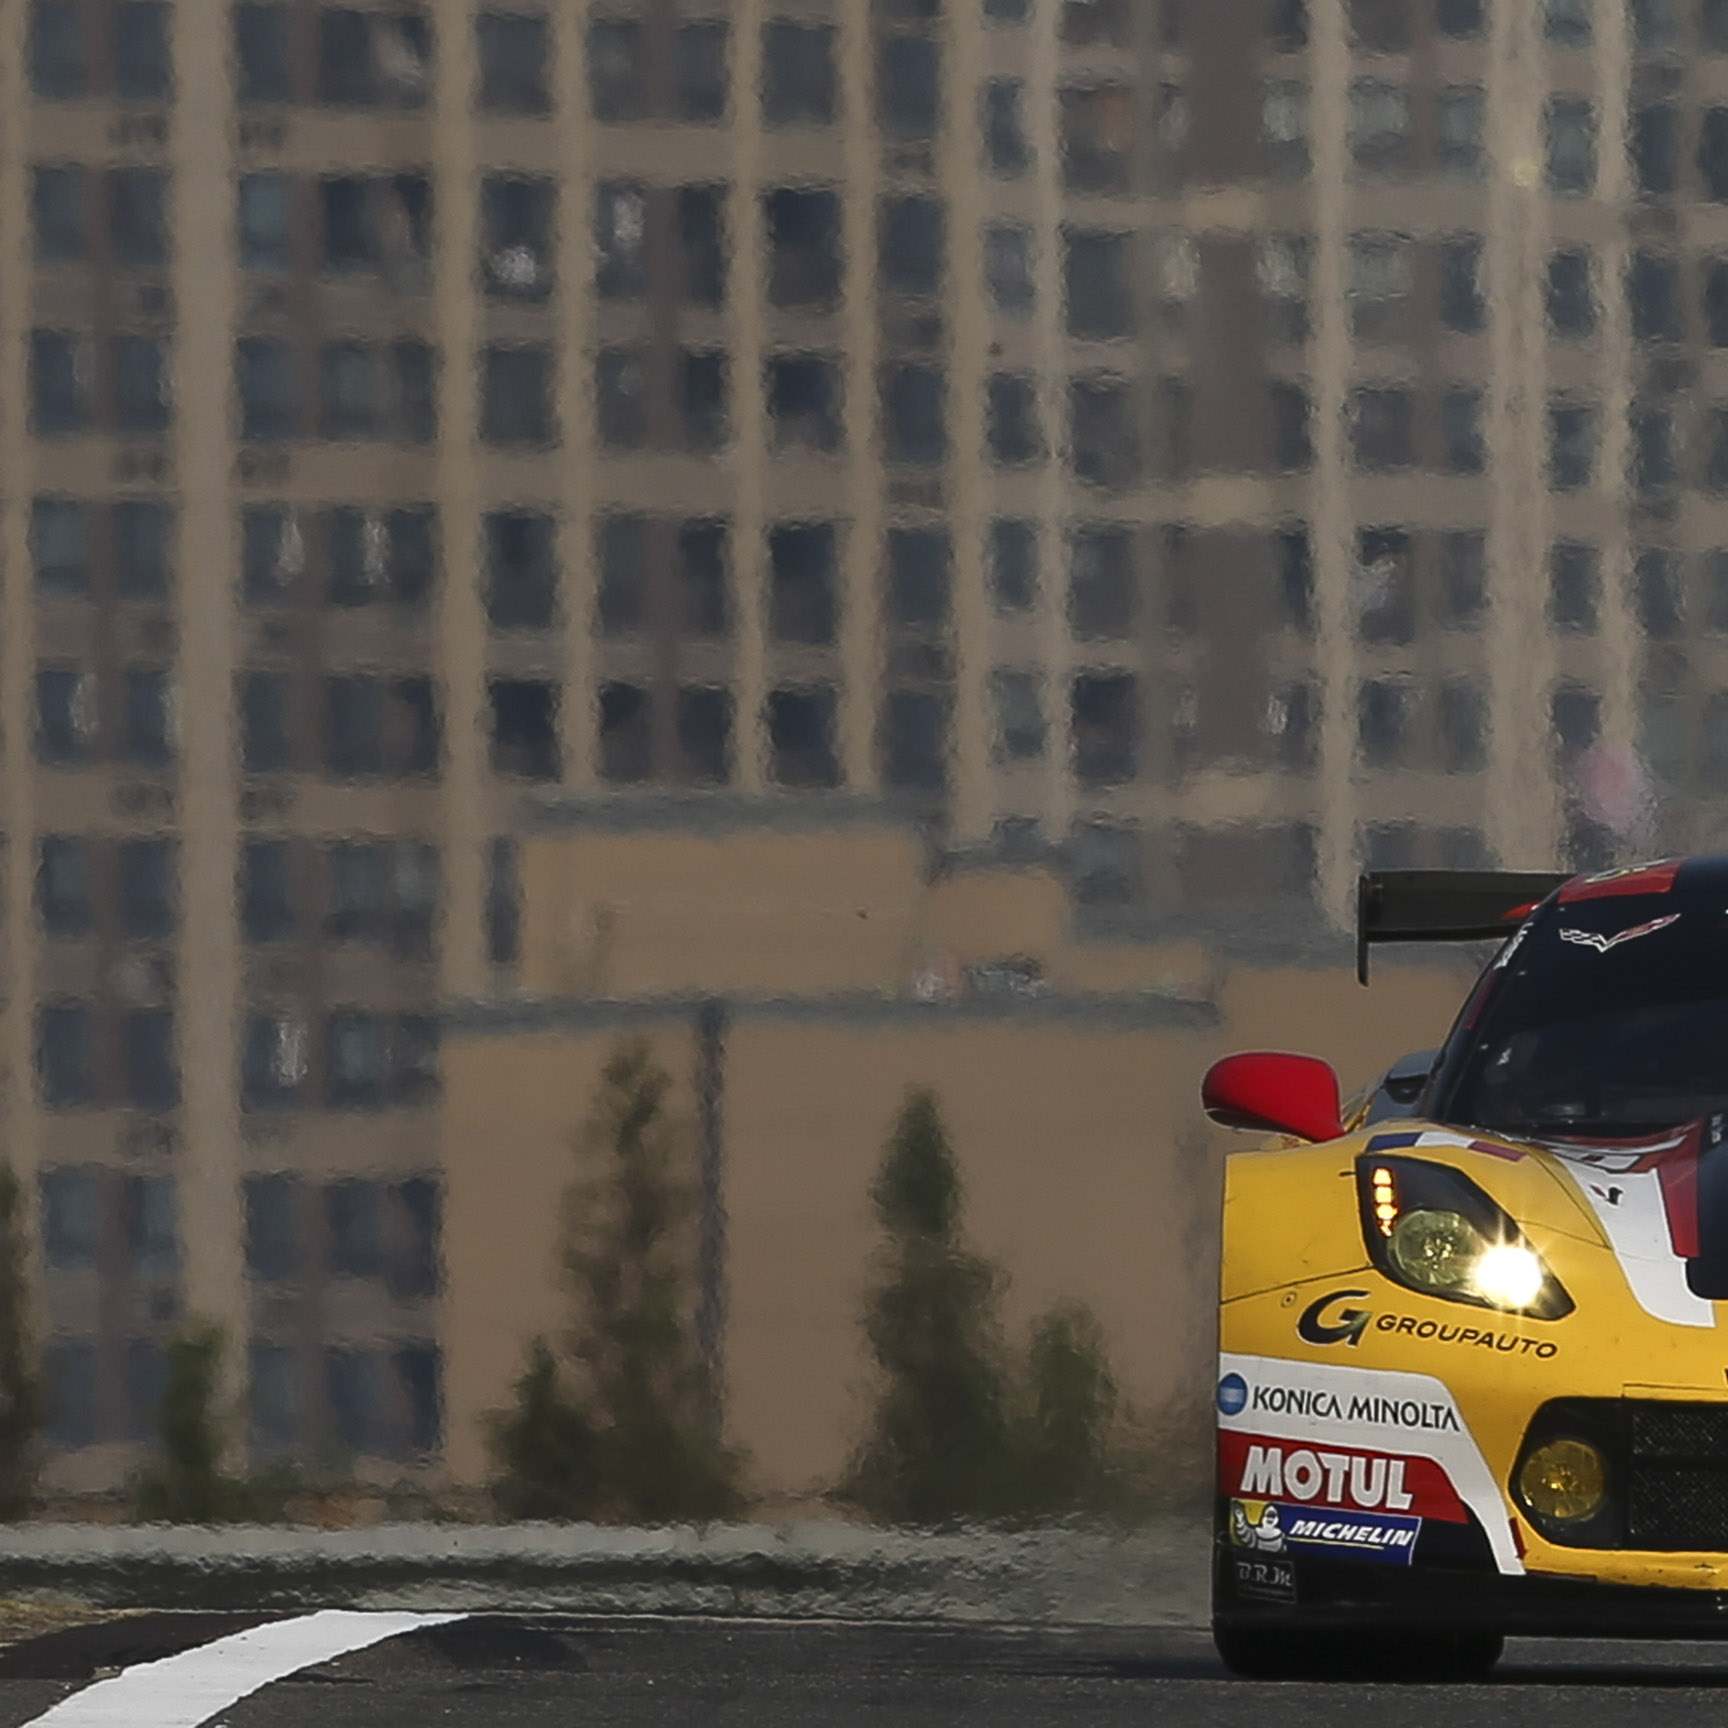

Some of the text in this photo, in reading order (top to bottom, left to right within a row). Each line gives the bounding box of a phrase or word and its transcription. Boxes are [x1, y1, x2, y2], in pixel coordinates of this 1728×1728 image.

[1375, 1314, 1558, 1359] GROUPAUTO
[1252, 1385, 1461, 1433] KONICA MINOLTA
[1239, 1445, 1414, 1511] MOTUL
[1289, 1519, 1415, 1547] MICHELIN
